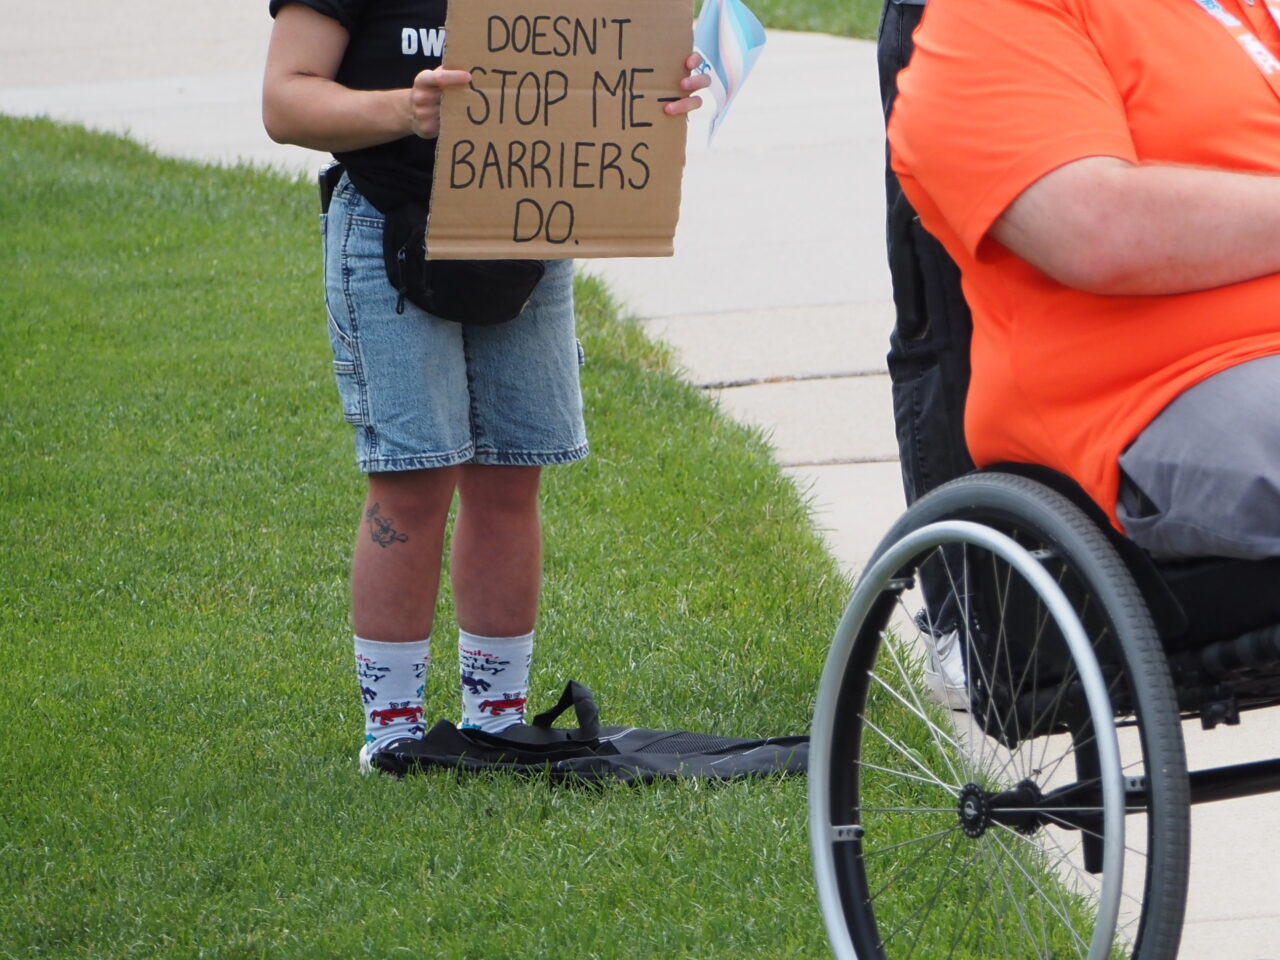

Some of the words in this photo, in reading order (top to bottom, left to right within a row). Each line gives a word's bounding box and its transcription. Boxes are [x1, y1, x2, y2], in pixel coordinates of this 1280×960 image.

[487, 15, 632, 60] DOESN'T
[466, 66, 569, 126] STOP
[450, 139, 650, 190] BARRIERS
[512, 198, 579, 245] DO.
[485, 657, 510, 665] be
